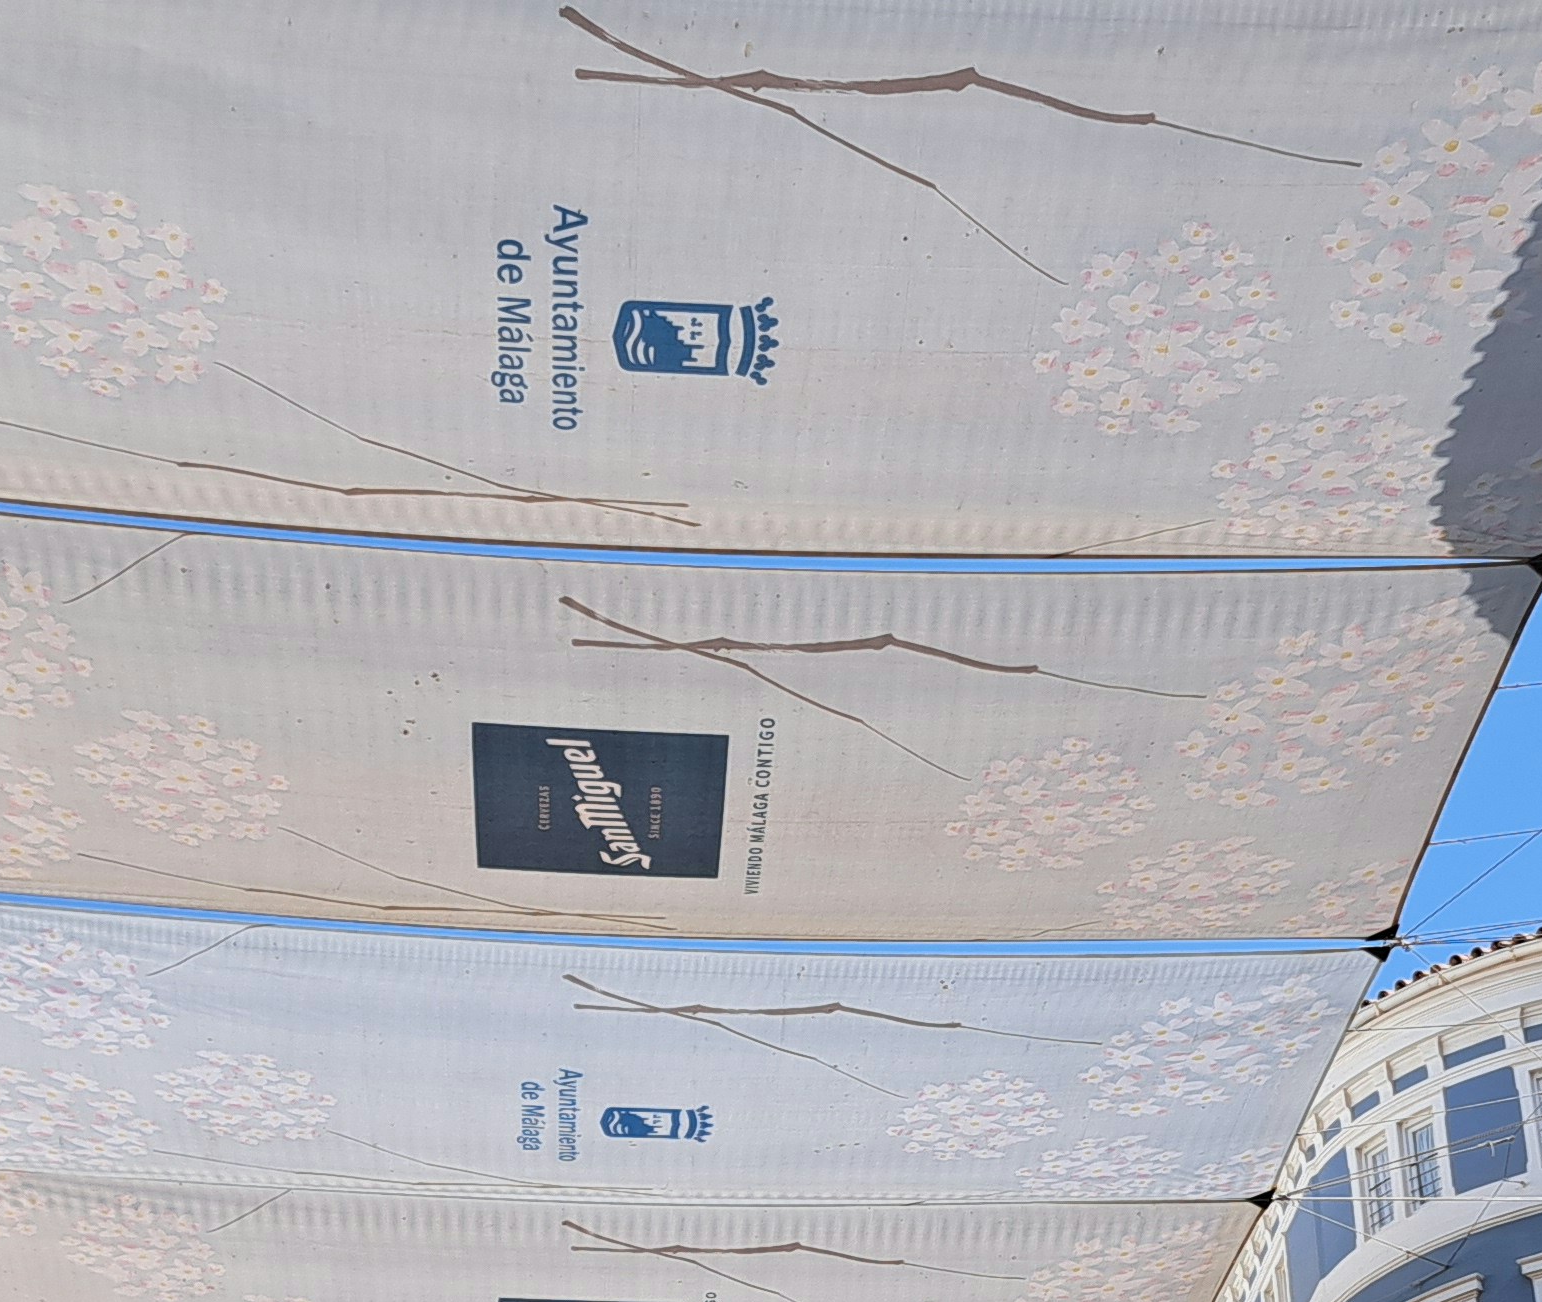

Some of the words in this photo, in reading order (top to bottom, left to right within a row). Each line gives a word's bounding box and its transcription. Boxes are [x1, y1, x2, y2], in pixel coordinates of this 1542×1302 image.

[496, 238, 532, 286] de
[544, 203, 589, 431] Ayuntamiento
[491, 297, 532, 404] Málaga
[755, 717, 776, 788] CONTIGO
[746, 793, 769, 843] MÁLAGA
[744, 847, 763, 895] VIVIENDO
[520, 1081, 546, 1100] de
[553, 1067, 584, 1162] Ayuntamiento
[516, 1104, 546, 1151] Málaga
